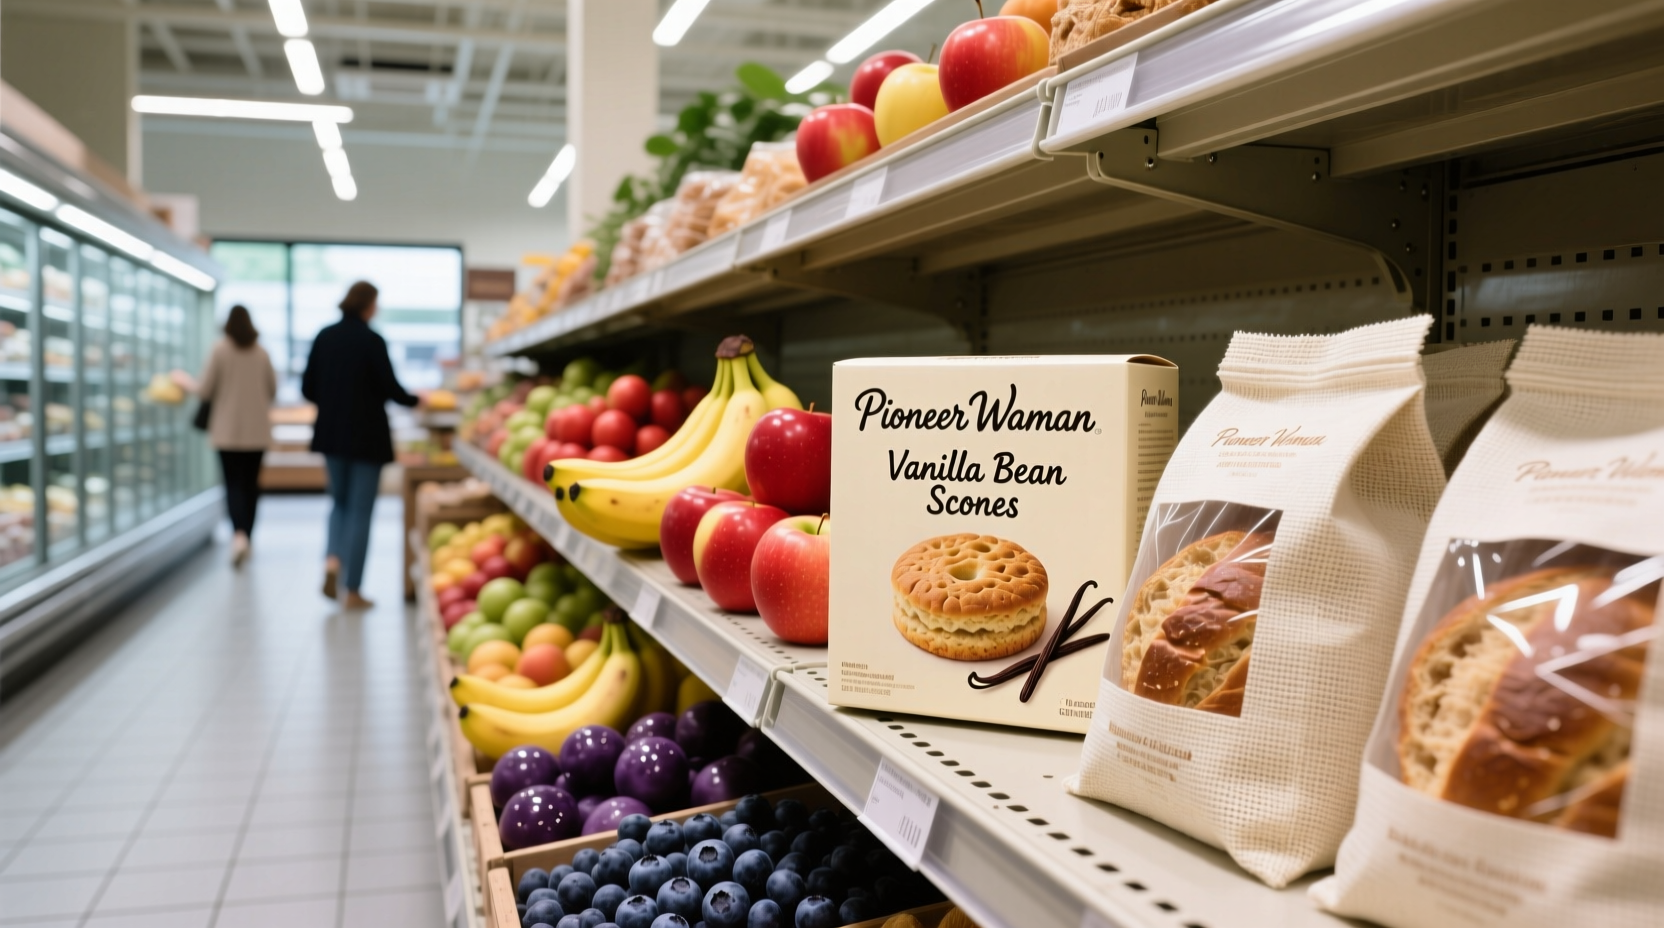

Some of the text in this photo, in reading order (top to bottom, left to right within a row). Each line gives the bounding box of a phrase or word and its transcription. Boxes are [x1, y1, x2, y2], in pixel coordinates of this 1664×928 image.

[855, 383, 1096, 433] Pioneer Waman
[889, 449, 1068, 485] Vanilla Bean
[926, 483, 1019, 519] Scones
